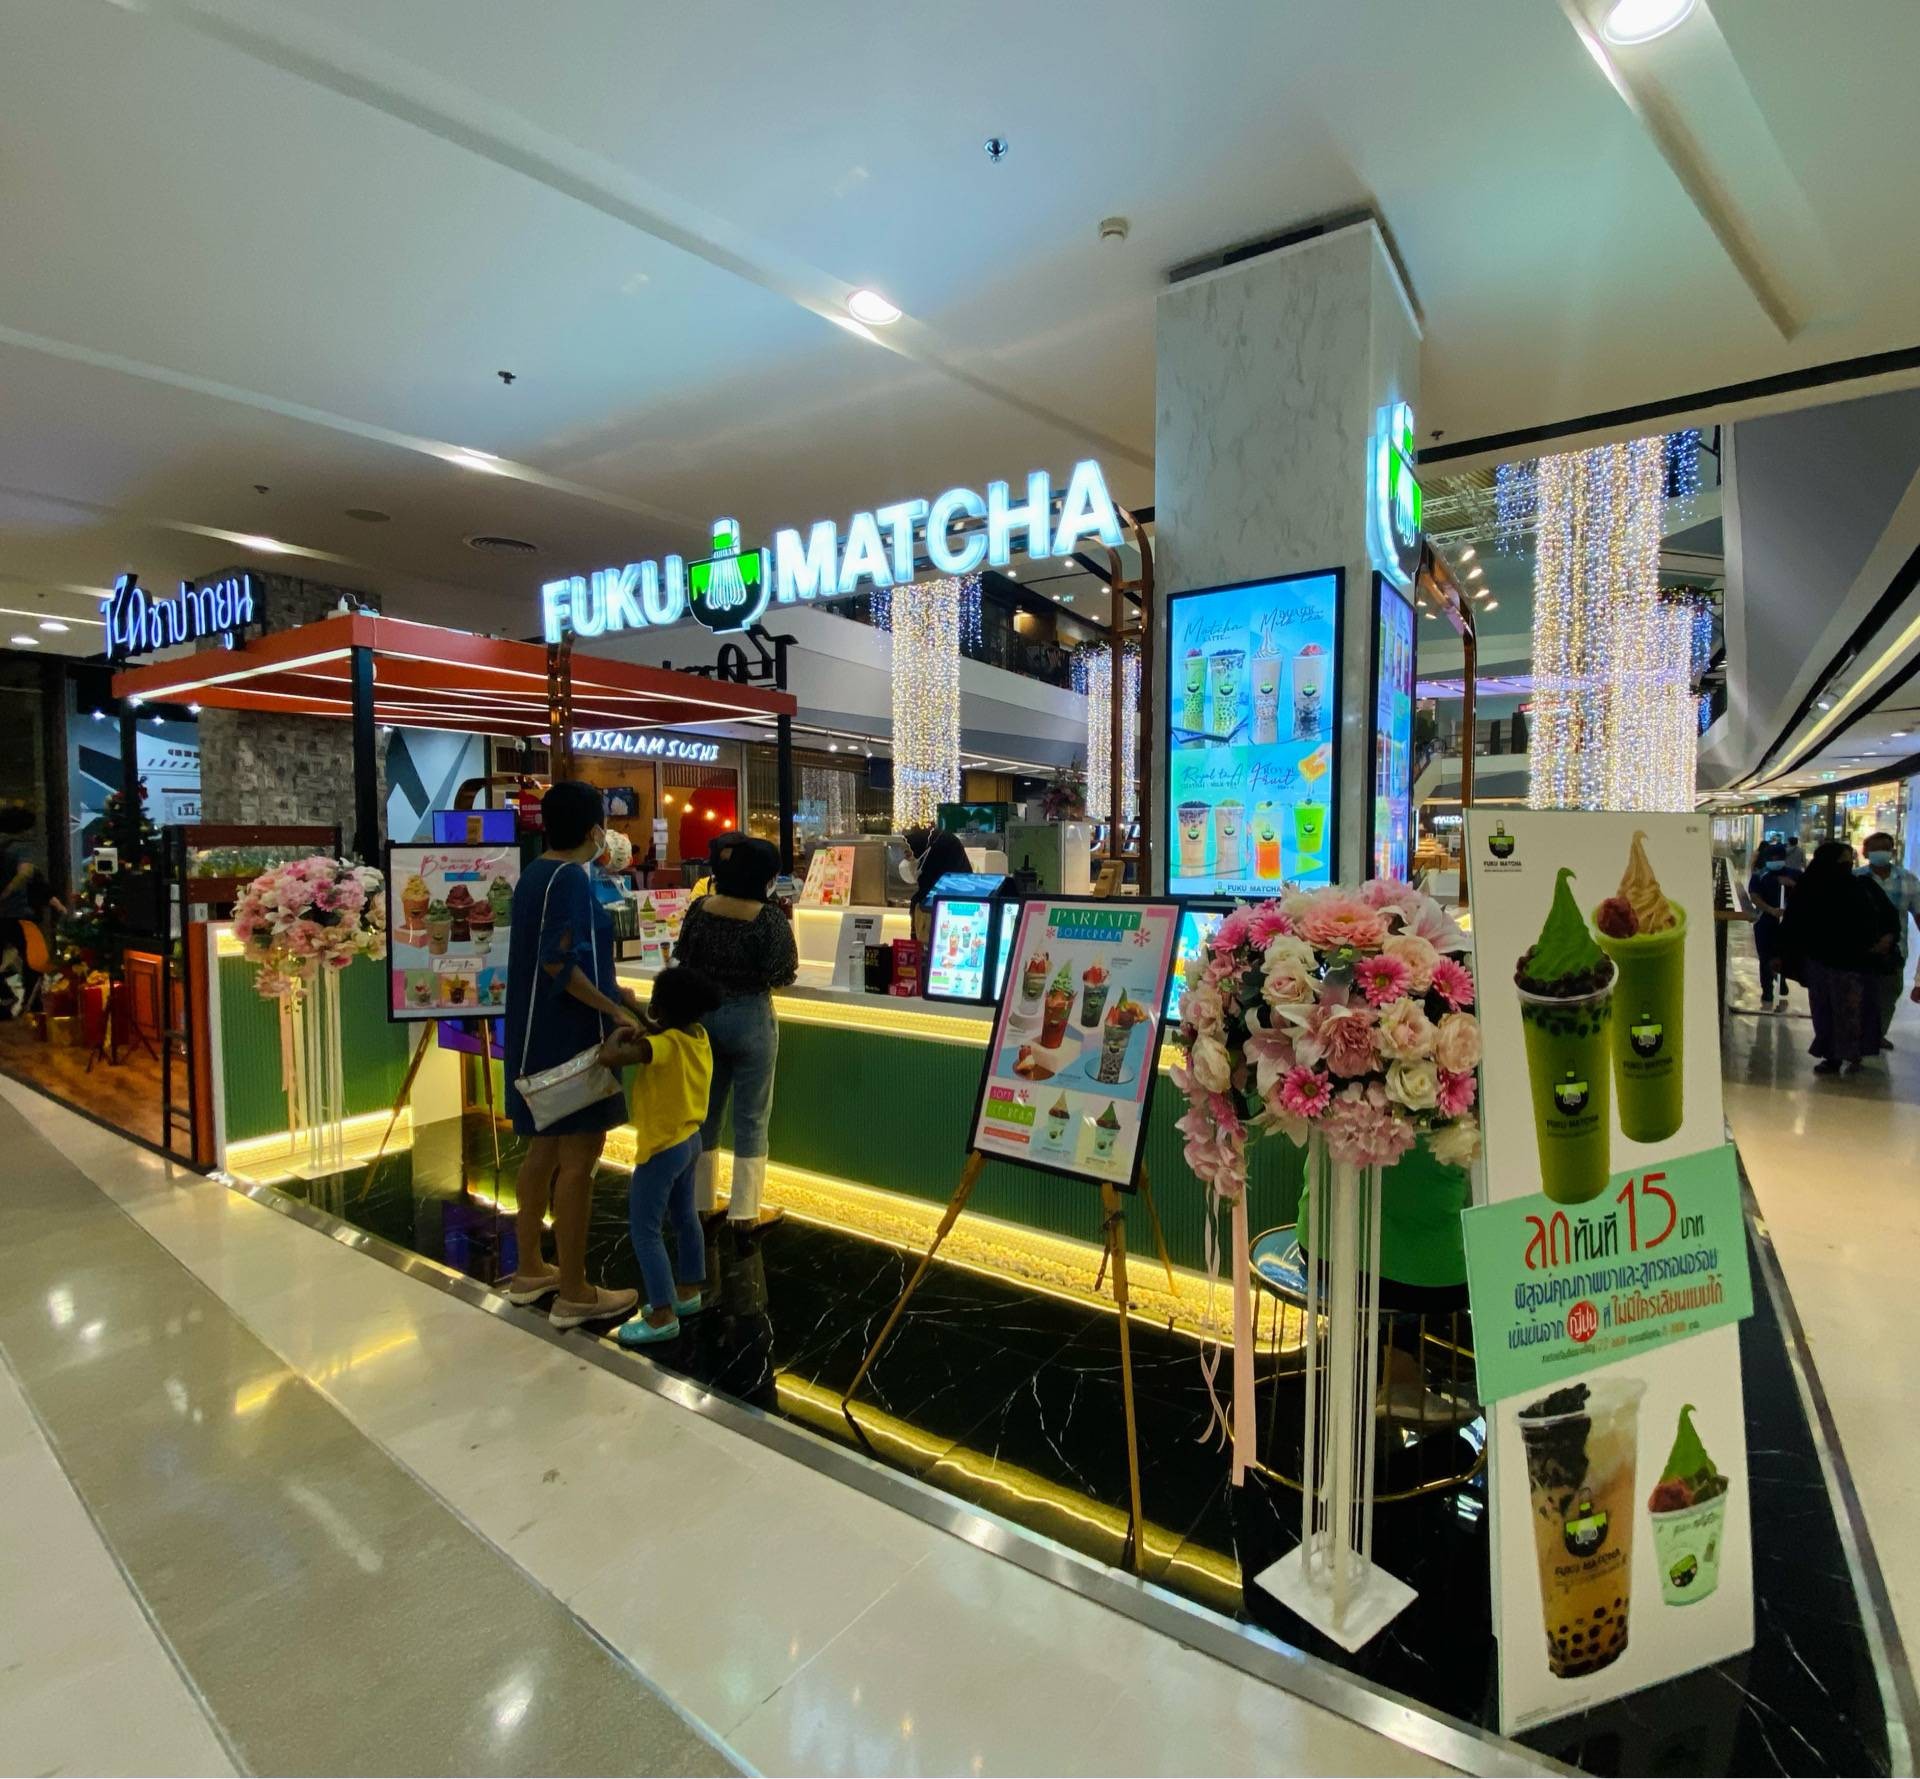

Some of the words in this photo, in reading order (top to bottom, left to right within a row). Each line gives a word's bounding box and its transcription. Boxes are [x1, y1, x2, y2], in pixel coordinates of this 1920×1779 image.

[541, 553, 684, 644] FUKU
[774, 458, 1125, 604] MATCHA
[666, 739, 720, 762] SUSHI
[1227, 884, 1247, 892] FUKU
[1616, 1172, 1677, 1252] 15
[1680, 1214, 1705, 1240] บาท
